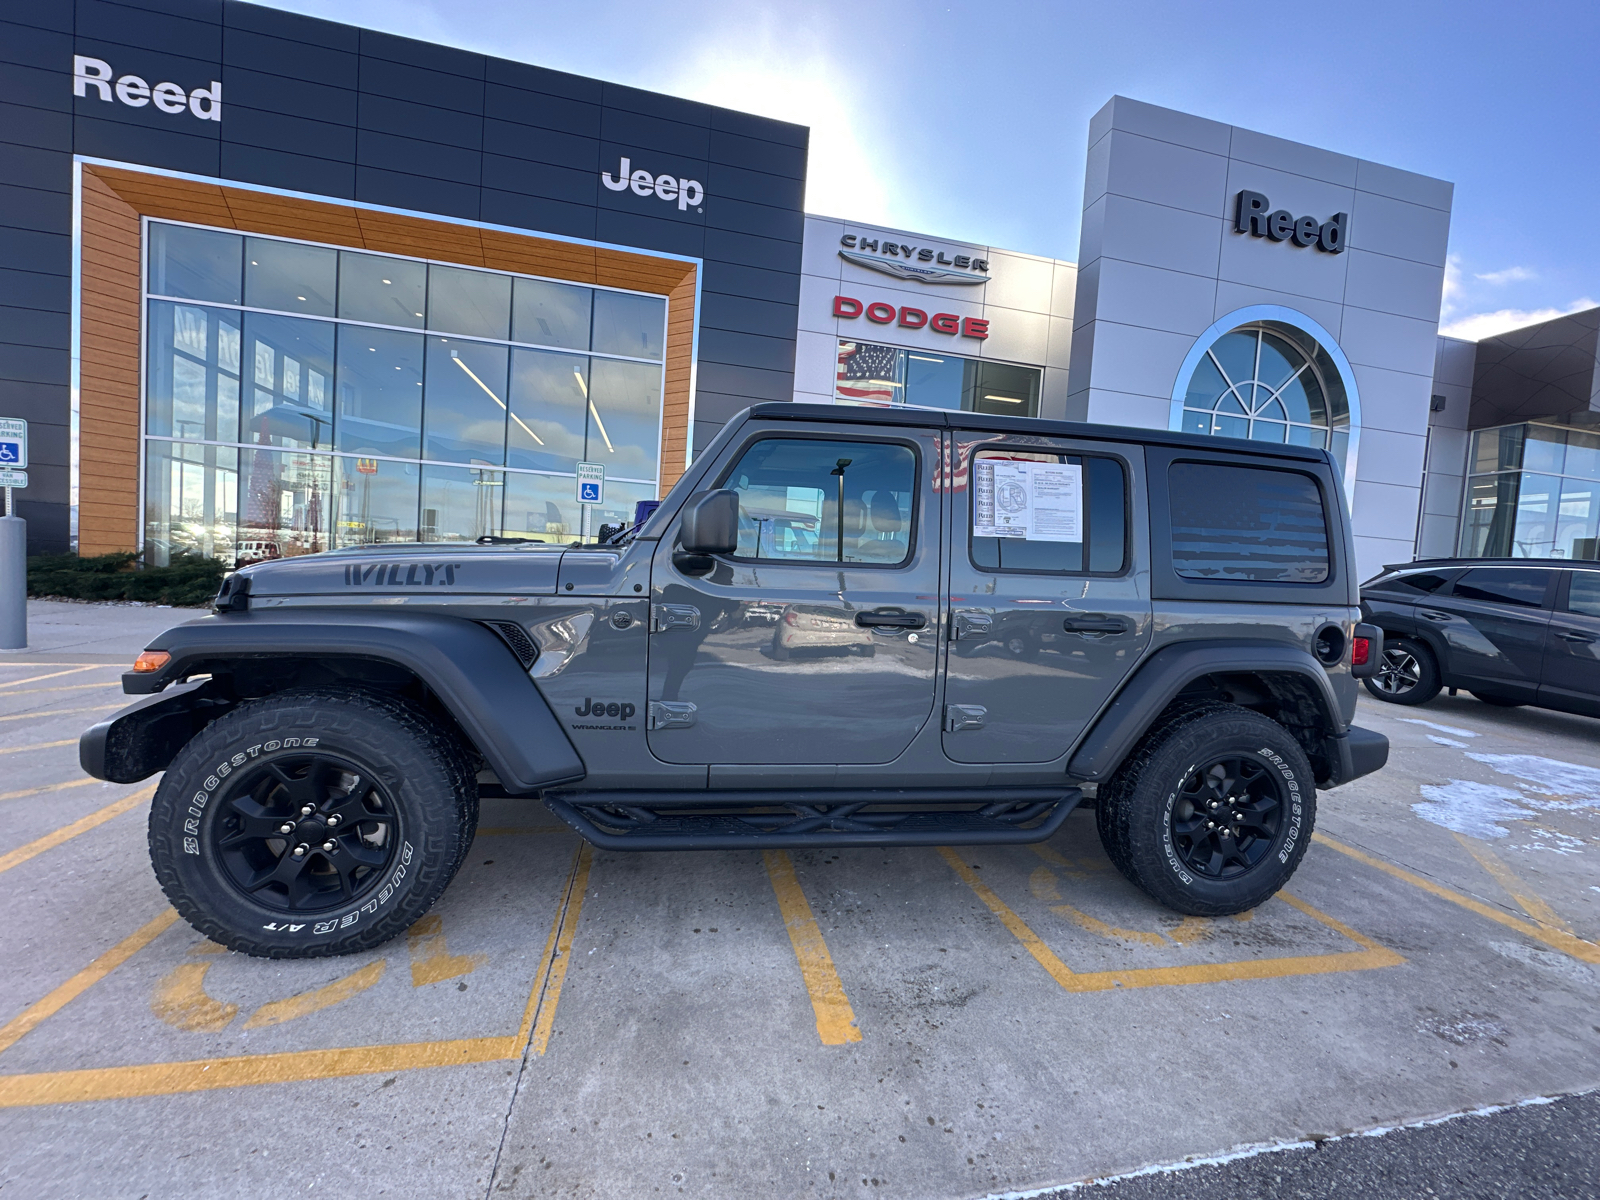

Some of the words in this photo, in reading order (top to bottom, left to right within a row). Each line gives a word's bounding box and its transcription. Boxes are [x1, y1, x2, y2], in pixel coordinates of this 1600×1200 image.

[73, 54, 222, 122] Reed
[602, 156, 704, 211] Jeep
[1234, 189, 1348, 254] Reed
[840, 234, 990, 272] CHRYSLER
[833, 295, 990, 340] DODGE
[578, 472, 603, 481] PARKING
[579, 465, 603, 474] RESERVED
[344, 563, 462, 586] WILLYS
[574, 697, 636, 721] Jeep
[183, 736, 321, 856] BRIDGESTONE
[1257, 747, 1303, 864] BRIDGESTONE
[1163, 792, 1194, 885] DUELER
[312, 840, 414, 935] DUELER
[262, 920, 307, 933] A/T
